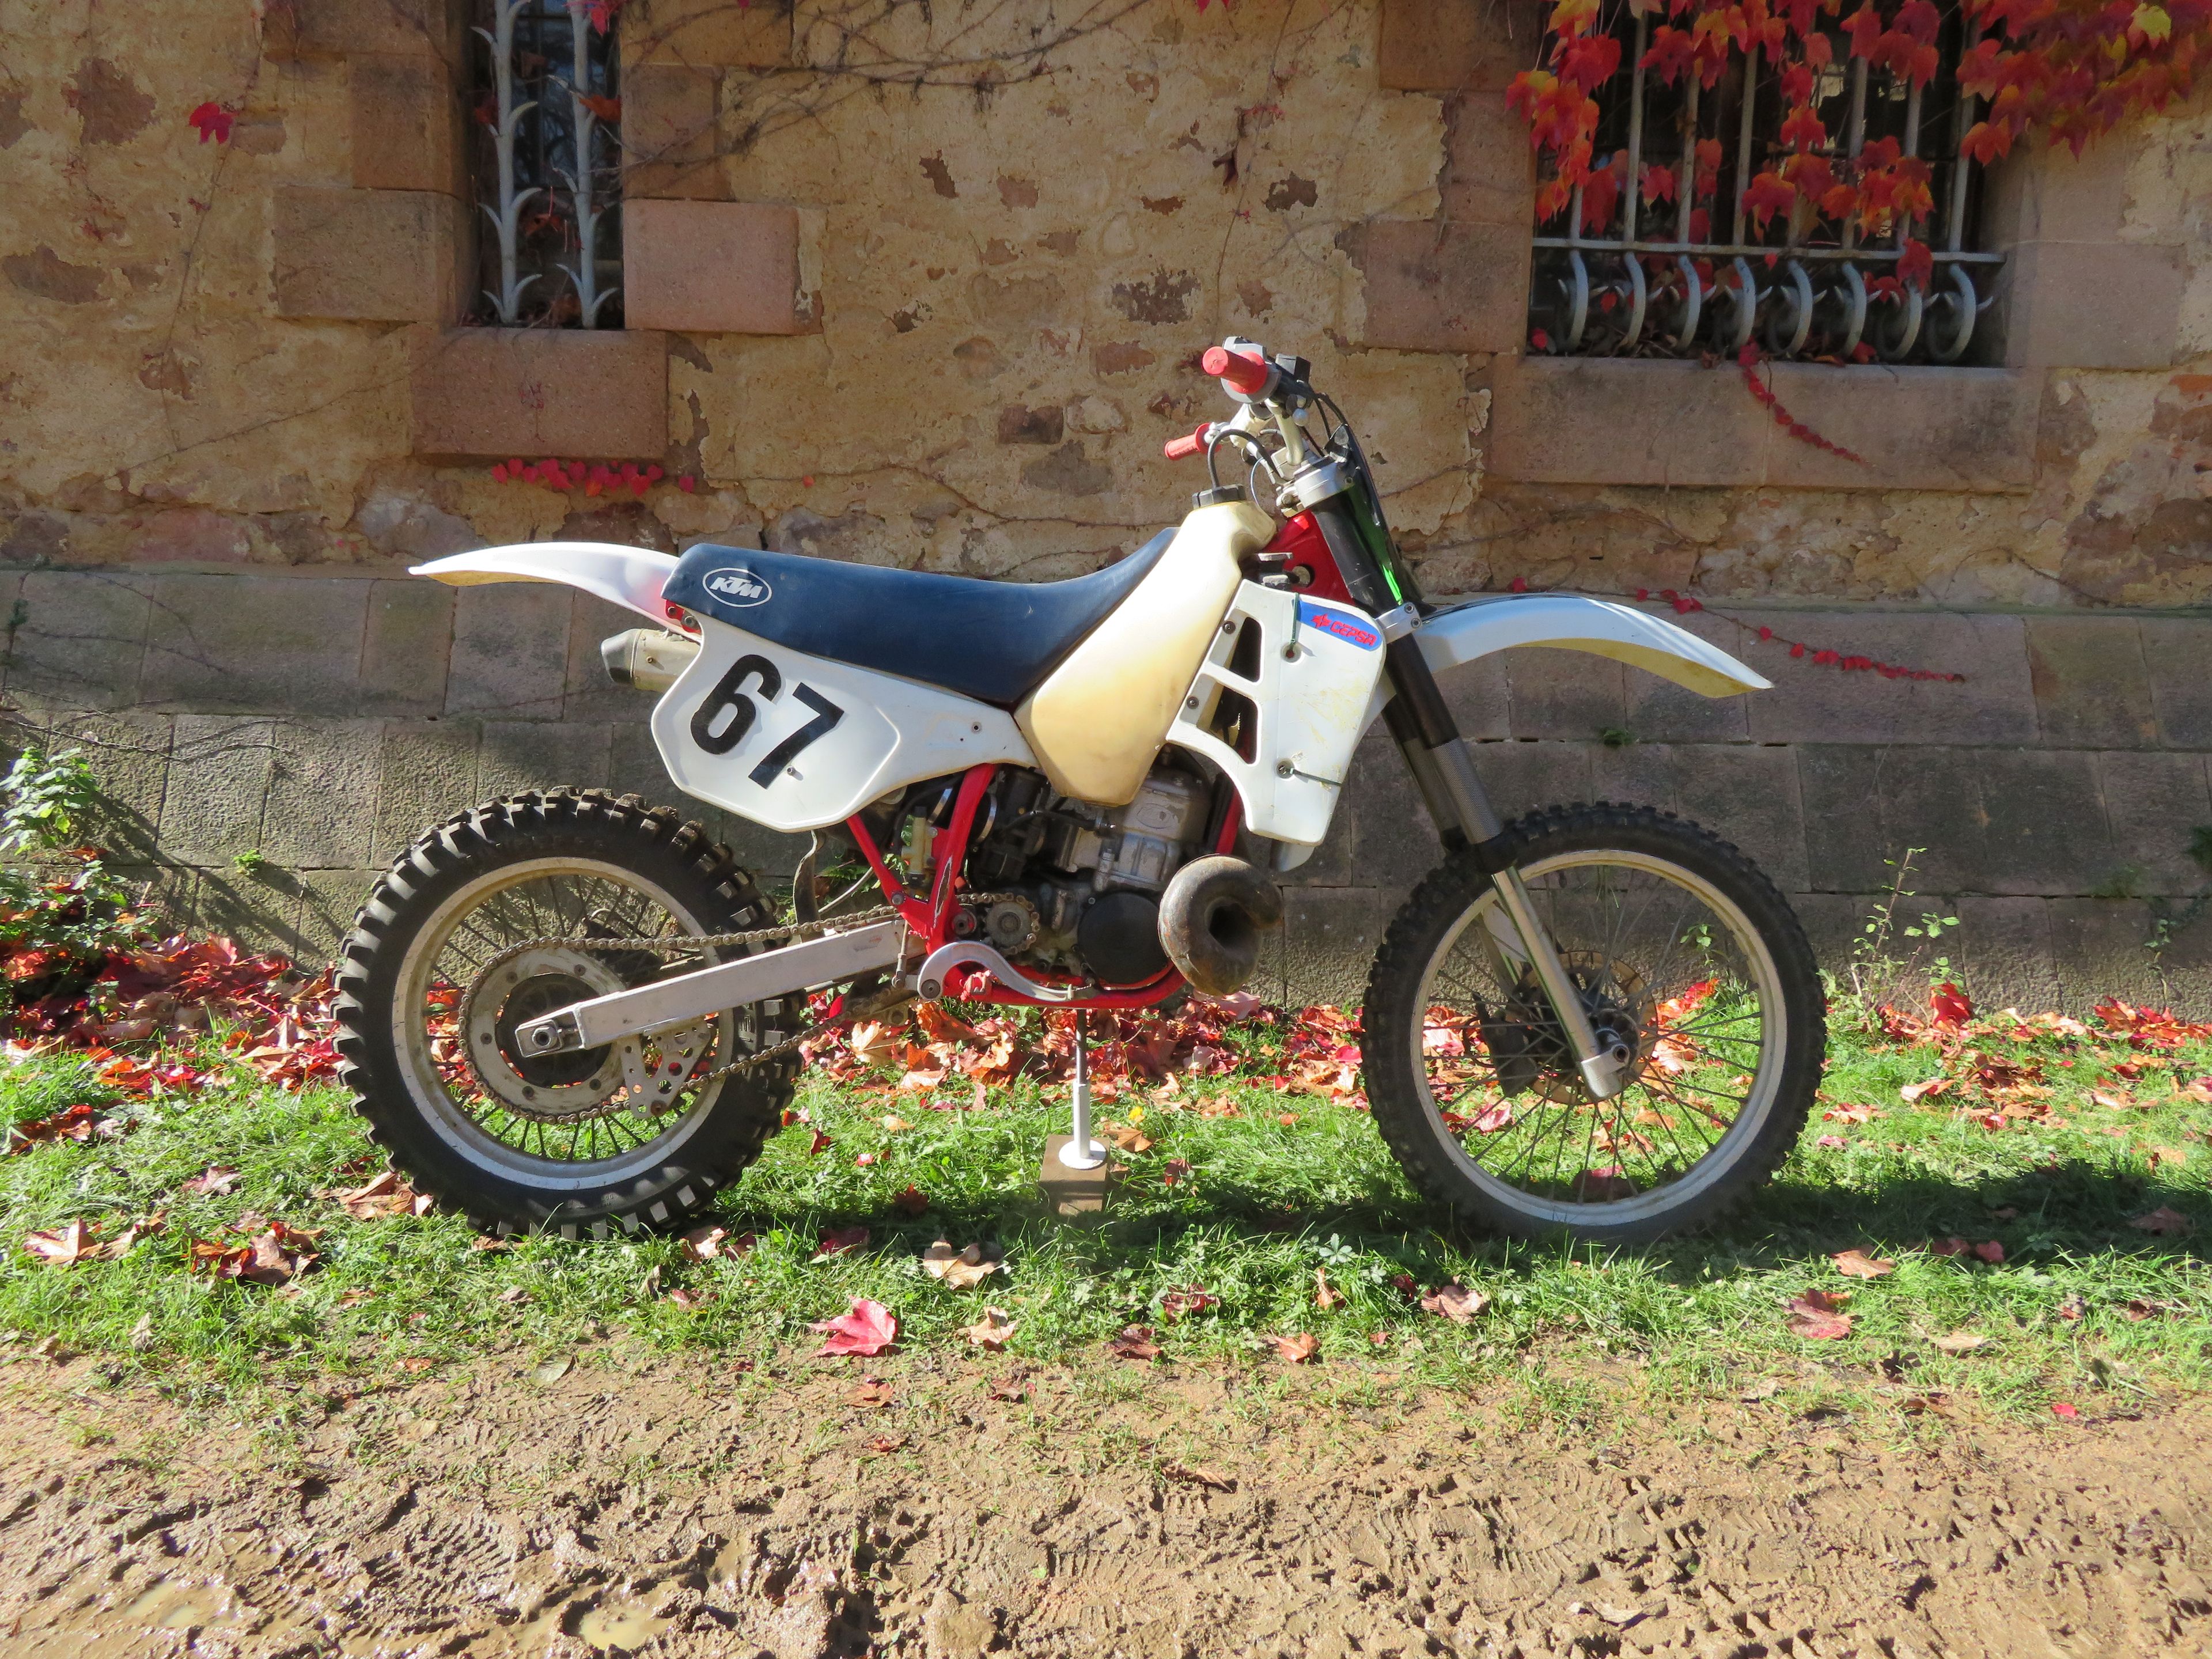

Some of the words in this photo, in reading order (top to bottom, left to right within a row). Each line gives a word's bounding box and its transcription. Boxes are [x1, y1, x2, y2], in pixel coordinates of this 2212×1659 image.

[709, 576, 763, 599] KTM
[1331, 621, 1377, 646] CEPSA
[690, 654, 844, 789] 67
